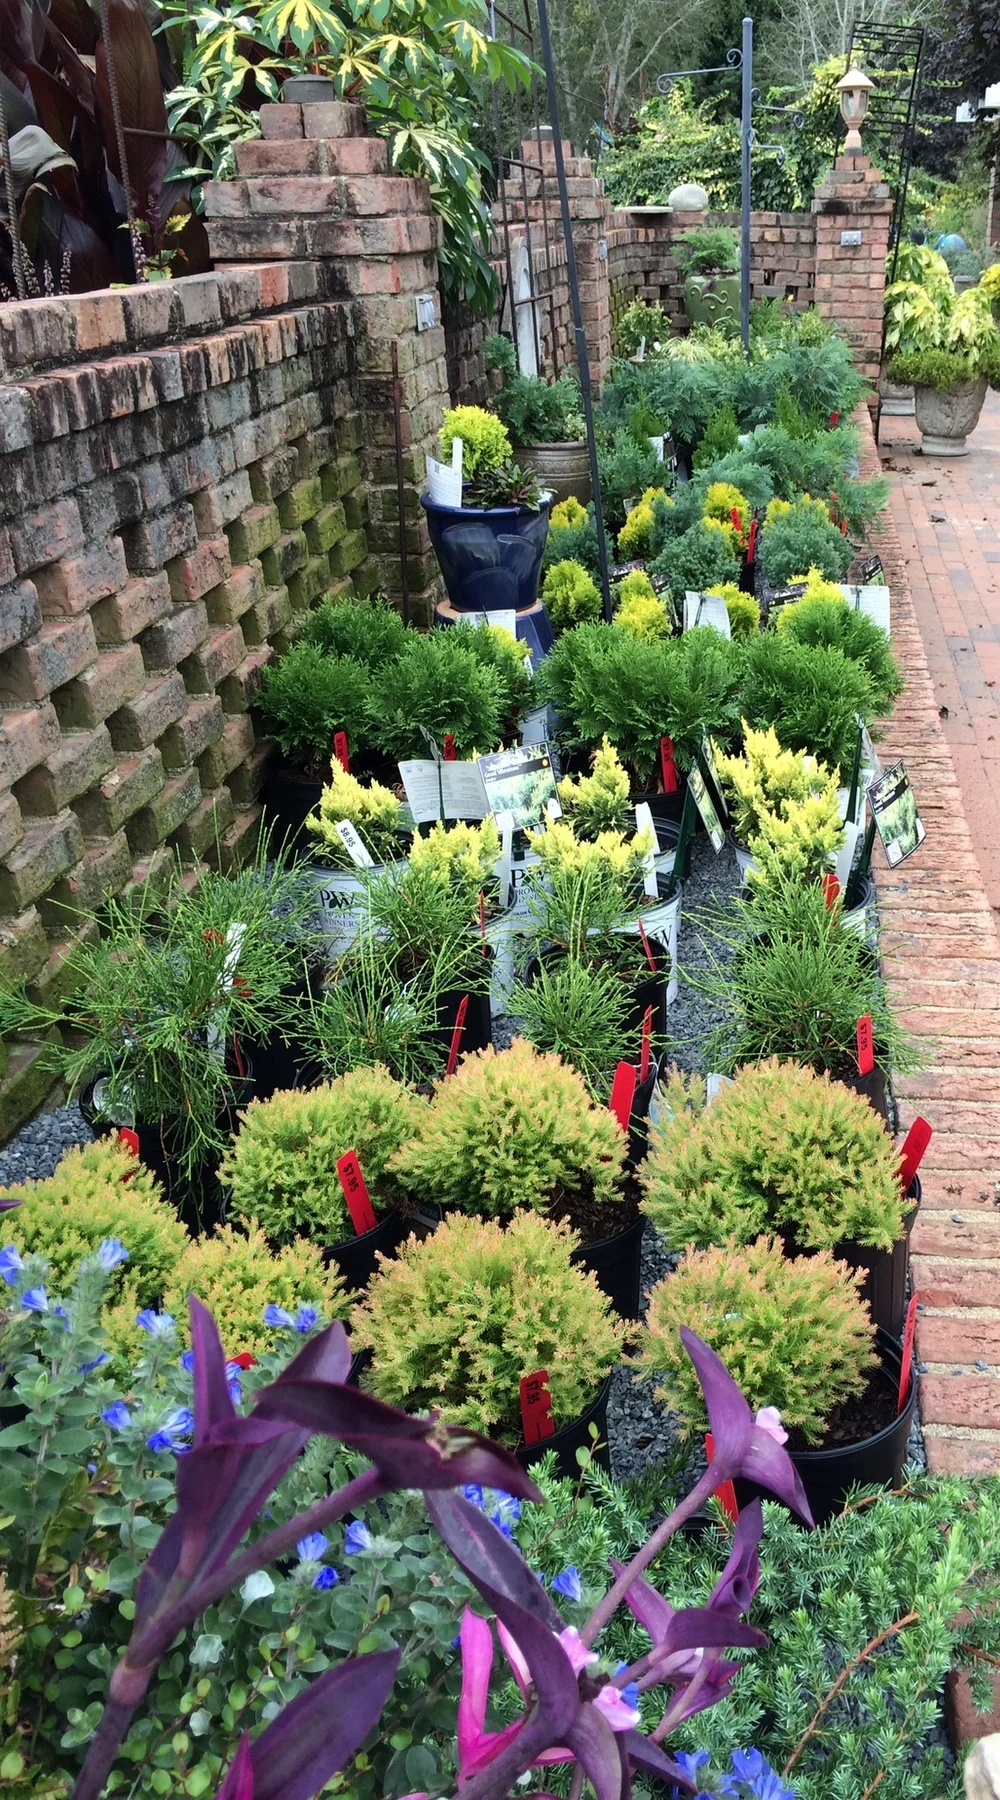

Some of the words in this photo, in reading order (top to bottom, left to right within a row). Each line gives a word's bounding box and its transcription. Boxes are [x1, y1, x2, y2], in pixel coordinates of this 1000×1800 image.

[340, 826, 356, 848] $8.95
[859, 1022, 869, 1051] $7.95
[343, 1162, 360, 1193] $7.95
